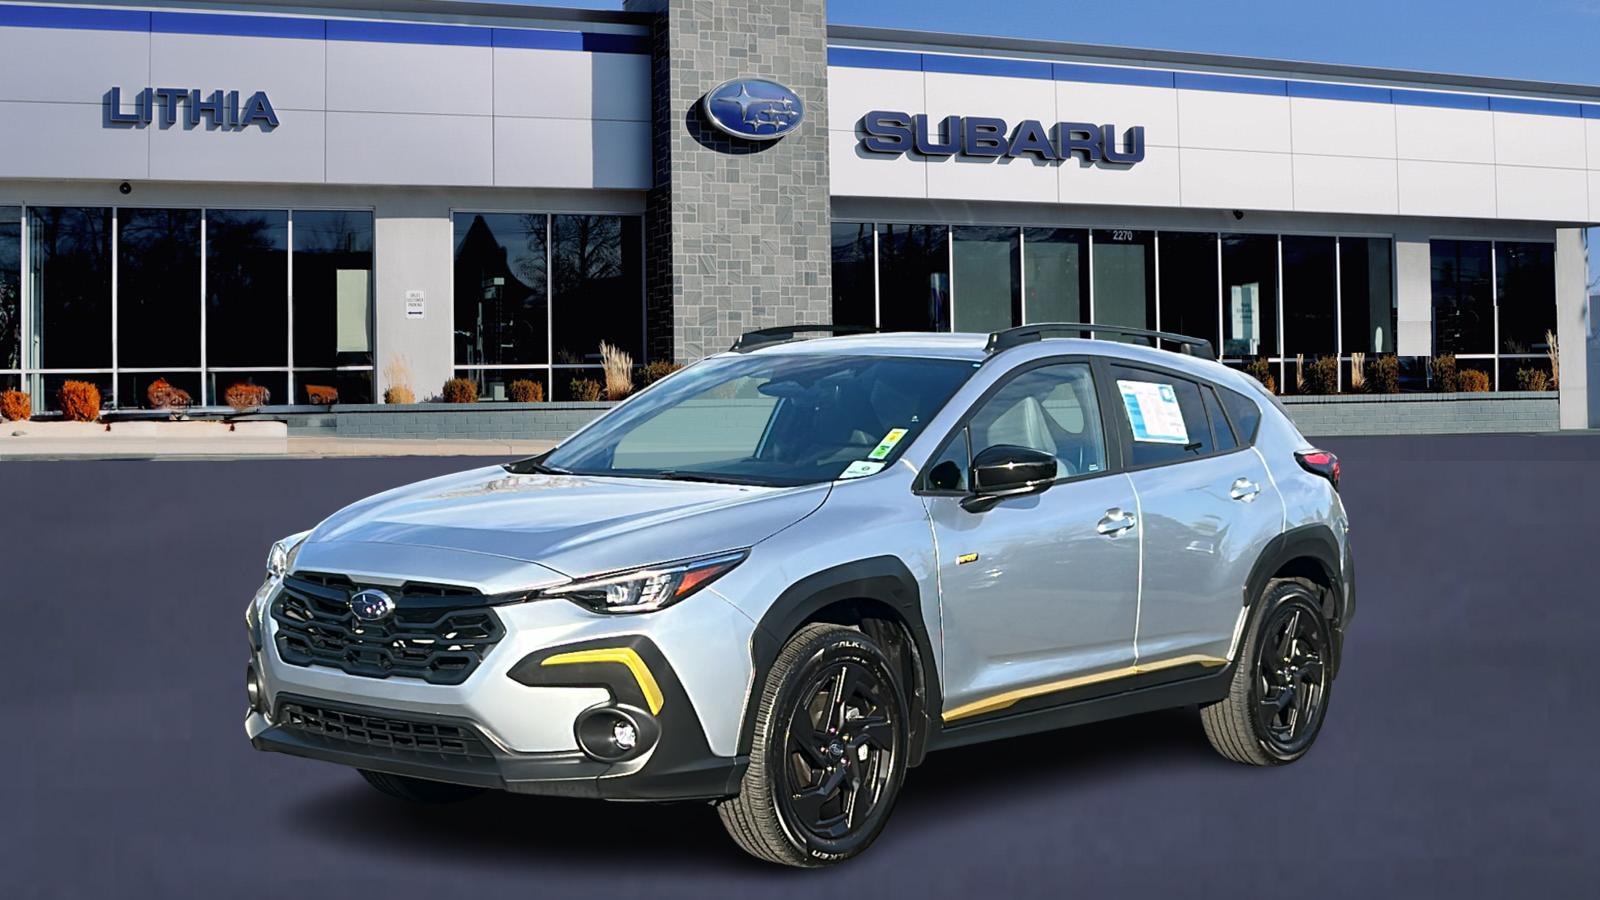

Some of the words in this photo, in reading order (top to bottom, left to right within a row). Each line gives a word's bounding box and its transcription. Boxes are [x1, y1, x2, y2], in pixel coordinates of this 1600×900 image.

[111, 87, 280, 126] LITHIA
[864, 111, 1145, 163] SUBARU
[1112, 230, 1133, 240] 2270
